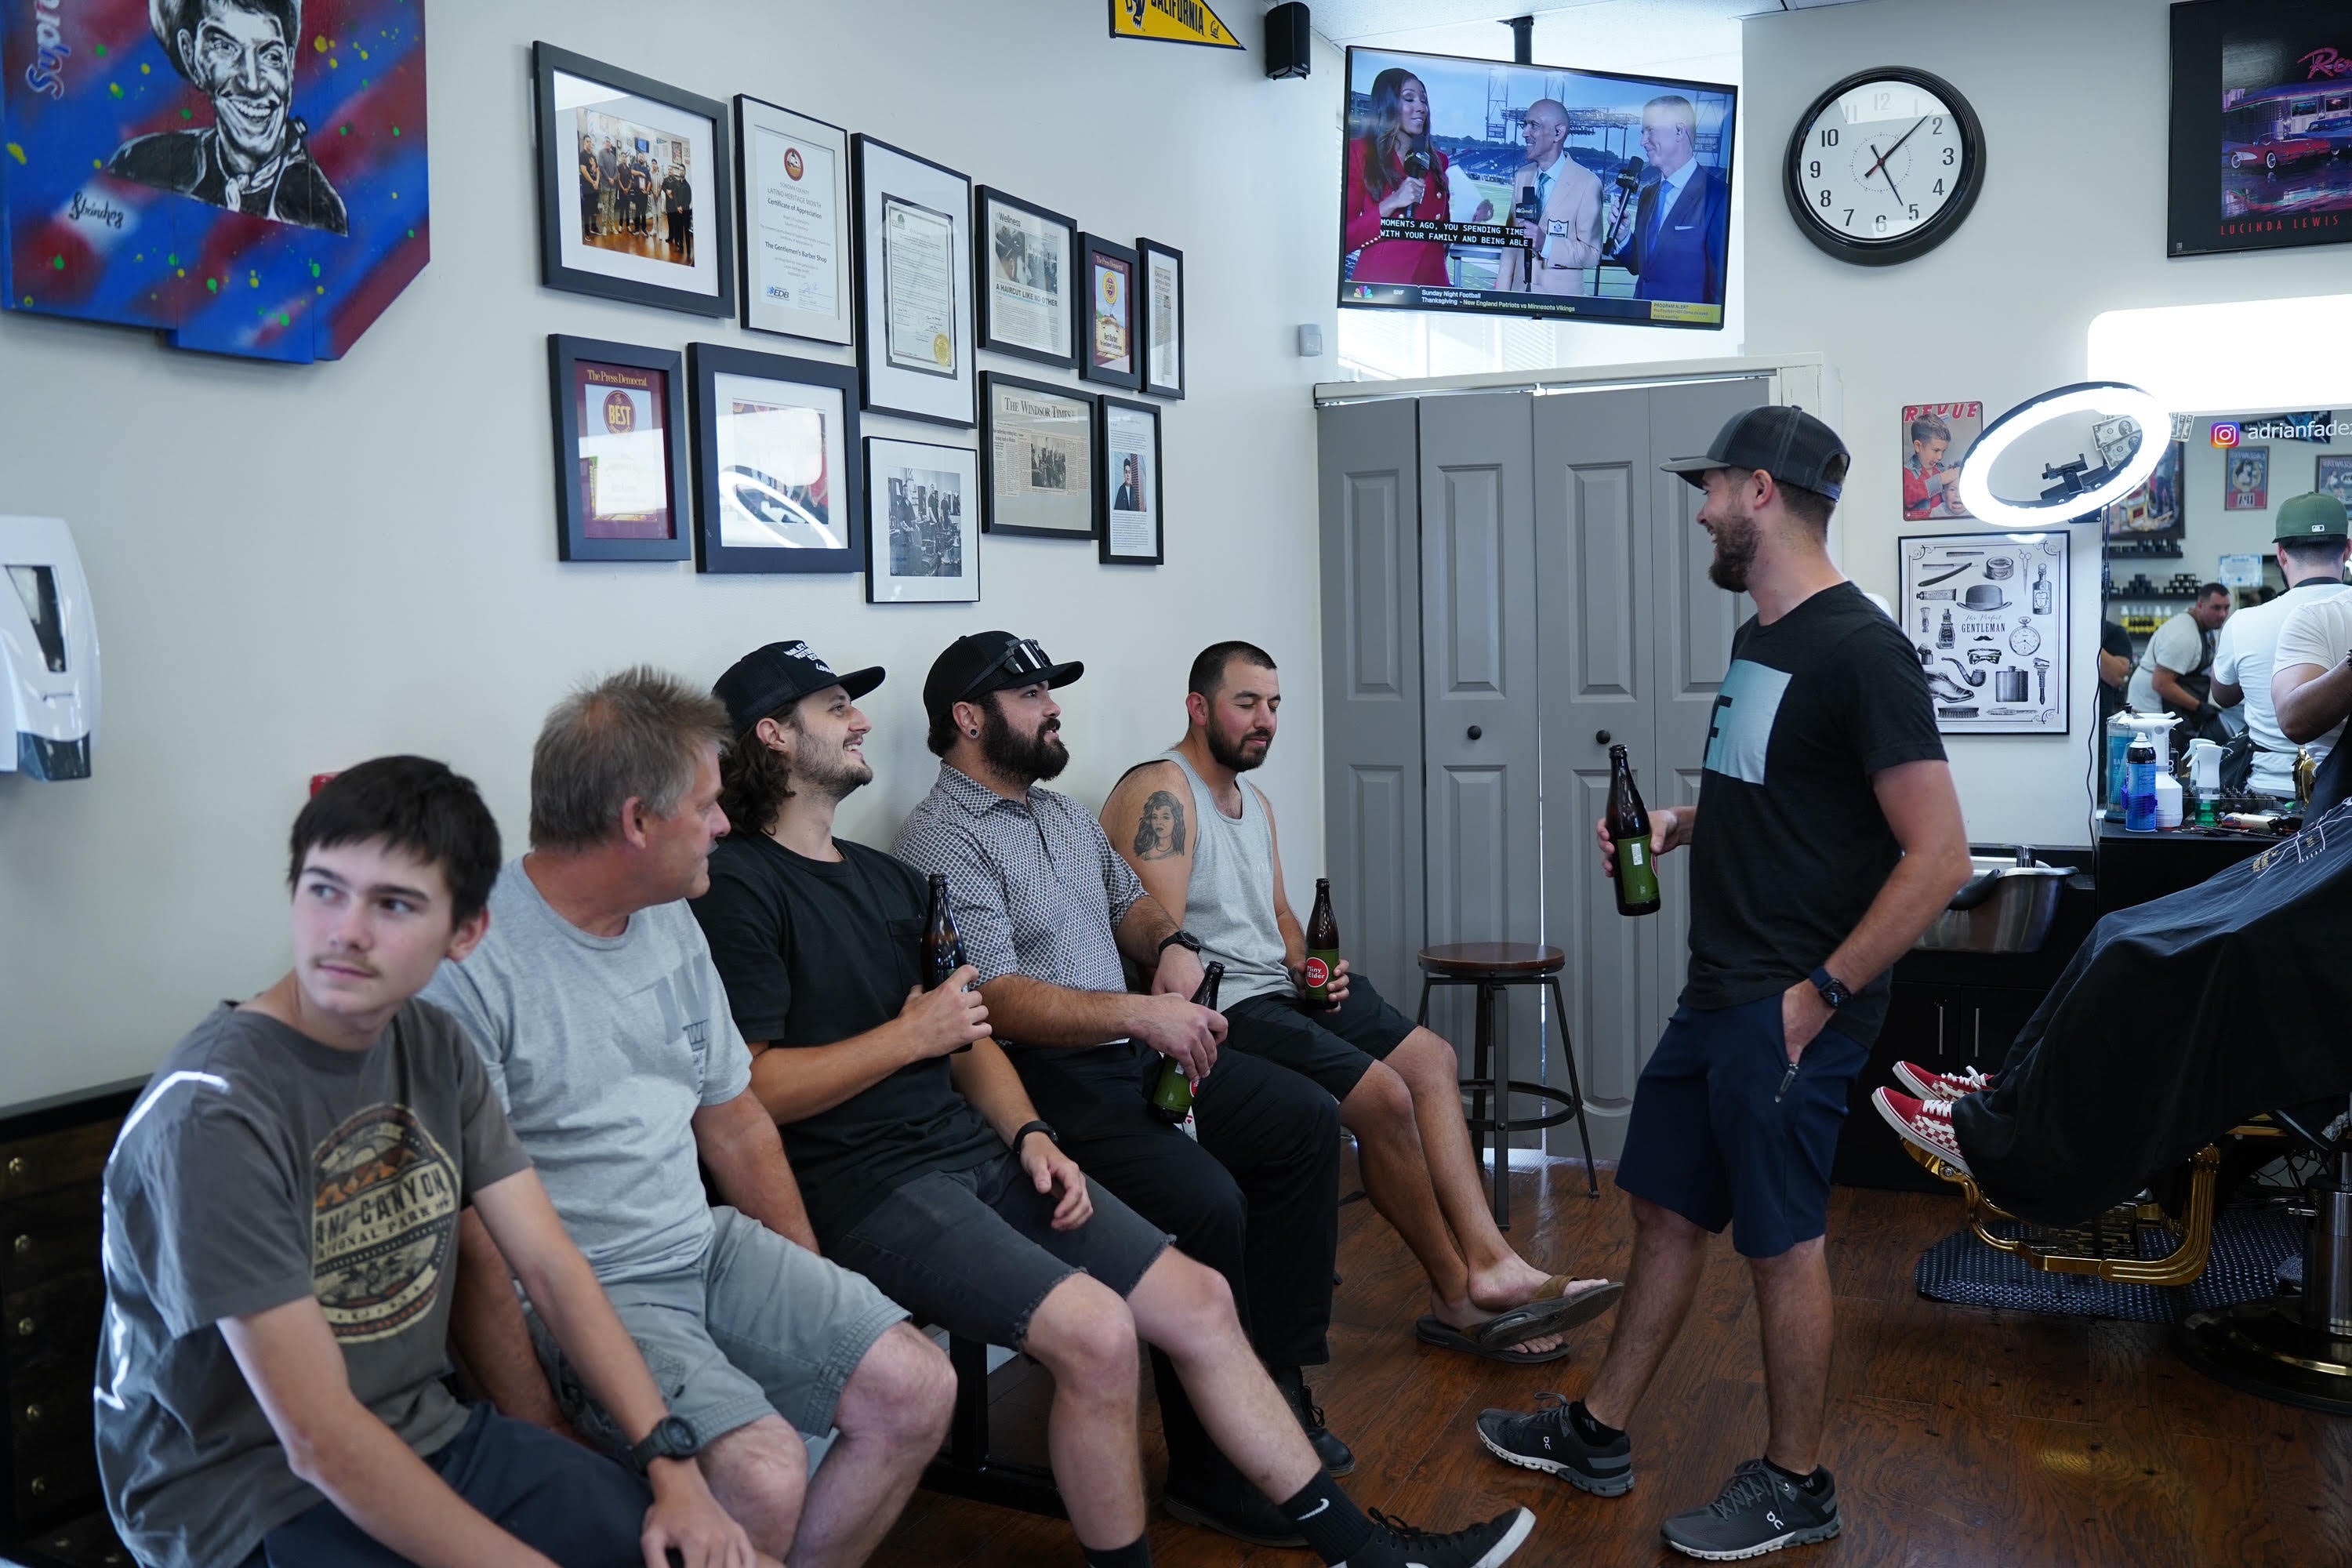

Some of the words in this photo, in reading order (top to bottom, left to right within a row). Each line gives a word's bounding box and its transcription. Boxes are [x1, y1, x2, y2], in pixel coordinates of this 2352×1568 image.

[1874, 93, 1891, 111] 12
[1846, 105, 1857, 122] 11
[1932, 118, 1943, 135] 2
[1821, 129, 1838, 147] 10
[1942, 147, 1955, 165] 3
[1809, 161, 1821, 178] 9
[1933, 179, 1944, 196] 4
[768, 187, 784, 198] LATINO
[784, 192, 805, 204] HERITAGE
[806, 198, 822, 209] MONTH
[1820, 190, 1831, 207] 8
[768, 198, 790, 210] Certificate
[796, 206, 822, 220] Appreciation
[1843, 209, 1855, 226] 7
[1908, 204, 1919, 221] 5
[998, 211, 1021, 227] Wellness
[1380, 219, 1415, 228] MOMENTS
[1420, 222, 1439, 230] AGO,
[1463, 225, 1501, 234] SPENDING
[1875, 215, 1887, 233] 6
[2220, 220, 2282, 235] LUCINDA
[2294, 216, 2339, 230] LEWIS
[1428, 233, 1457, 241] FAMILY
[765, 241, 774, 249] The
[774, 244, 801, 256] Gentlemen's
[801, 251, 816, 260] Barber
[816, 255, 827, 263] Shop
[773, 289, 789, 299] EDB
[1000, 285, 1022, 296] HAIRCUT
[1022, 291, 1033, 300] LIKE
[1042, 297, 1058, 307] OTHER
[1421, 289, 1443, 298] Sunday
[1421, 296, 1458, 306] Thanksgiving
[587, 369, 601, 381] The
[601, 371, 618, 383] Press
[618, 373, 648, 387] Democrat
[608, 404, 631, 426] BEST
[1004, 397, 1019, 412] THE
[1021, 400, 1051, 418] WINDSOR
[1051, 405, 1071, 419] TIMES
[1904, 402, 1978, 422] REVUE
[2248, 419, 2352, 440] adrianfade
[1962, 622, 2005, 633] GENTLEMAN
[361, 1169, 446, 1225] CANYON
[387, 1206, 430, 1232] PARK
